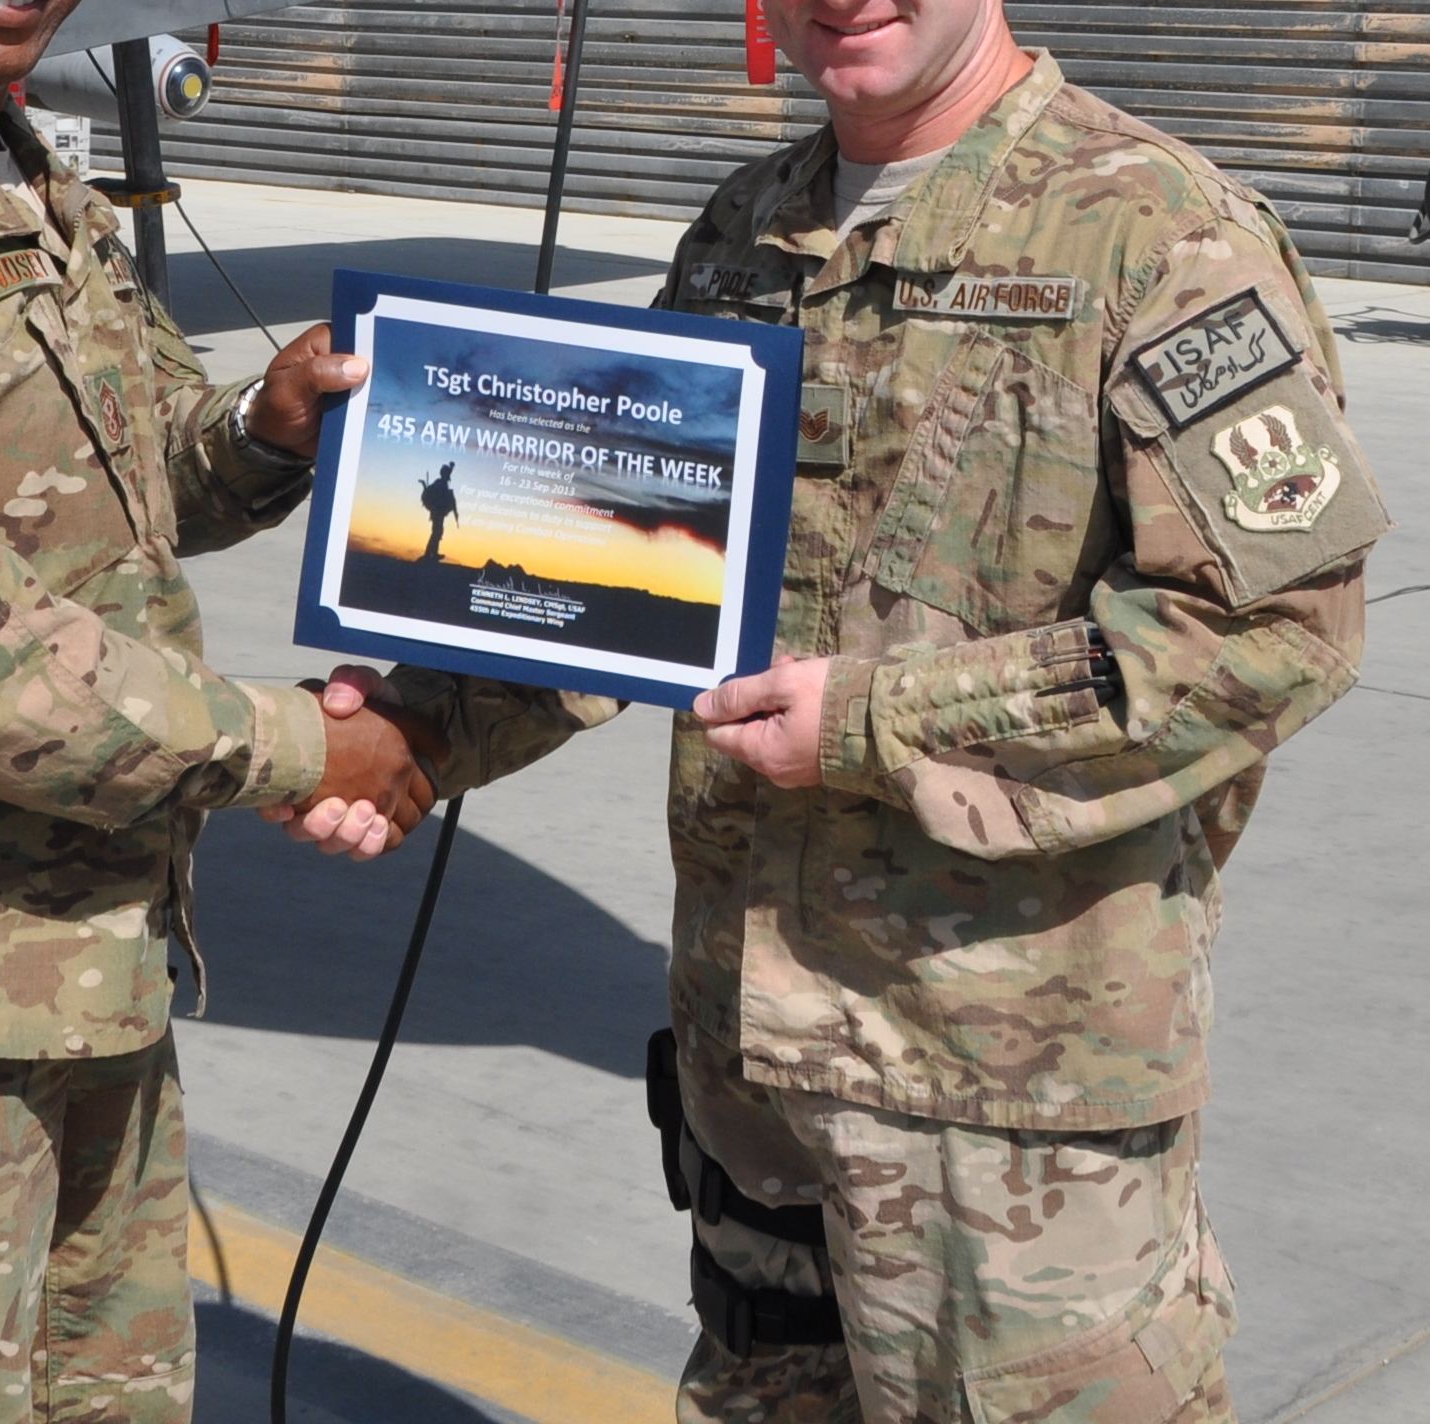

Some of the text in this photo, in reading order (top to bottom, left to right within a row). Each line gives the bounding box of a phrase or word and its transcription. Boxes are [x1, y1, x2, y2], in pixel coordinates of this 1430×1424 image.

[707, 269, 759, 300] POOLE
[899, 277, 1071, 313] U.S. AIR FORCE
[1164, 311, 1245, 373] ISAF
[423, 365, 683, 425] TSgt Christopher Poole
[489, 409, 591, 433] Has been selected as the
[377, 414, 723, 486] 455 AEW WARRIOR OF THE WEEK
[499, 476, 511, 487] 16
[519, 479, 531, 490] 23
[533, 481, 550, 494] Sep
[551, 483, 576, 497] 2013
[503, 461, 575, 483] For the week of
[459, 485, 615, 519] For your exceptional commitment
[459, 500, 612, 533] and dedication to duty in support
[1271, 491, 1326, 525] USAFCENT
[516, 523, 553, 538] Combat
[554, 530, 607, 547] Operations
